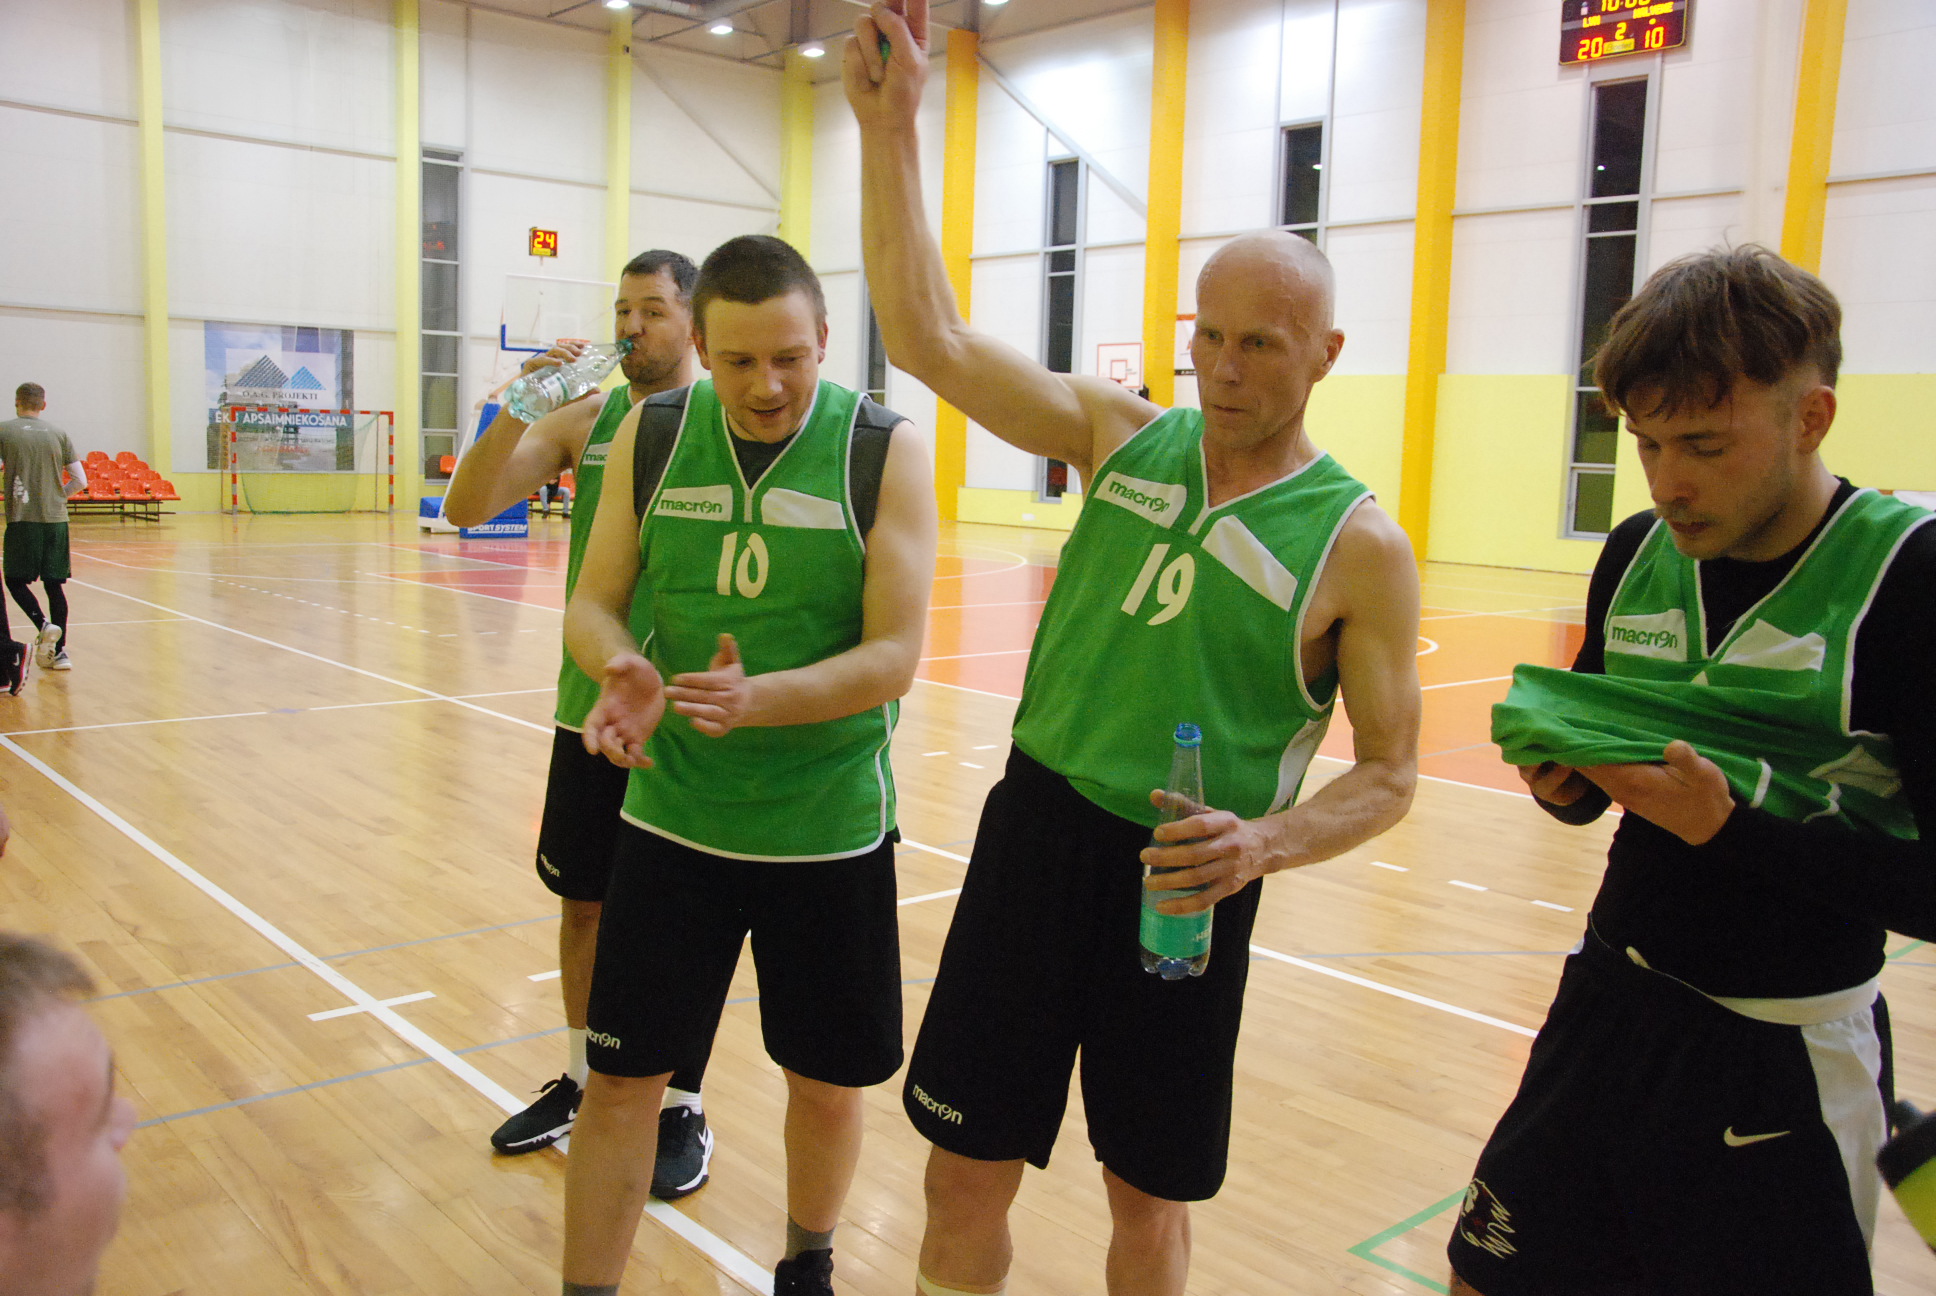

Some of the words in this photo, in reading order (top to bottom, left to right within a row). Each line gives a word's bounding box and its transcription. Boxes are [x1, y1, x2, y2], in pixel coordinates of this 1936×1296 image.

[1615, 22, 1627, 40] 2
[1645, 26, 1664, 48] 10
[1577, 37, 1603, 60] 20
[534, 231, 555, 248] 24
[272, 391, 318, 400] PROJEKTI
[660, 498, 722, 514] macron
[1108, 480, 1170, 513] macron
[495, 524, 527, 533] SYSTEM
[716, 531, 769, 599] 10
[1120, 543, 1195, 626] 19
[1611, 625, 1678, 648] macron
[912, 1083, 963, 1125] macron
